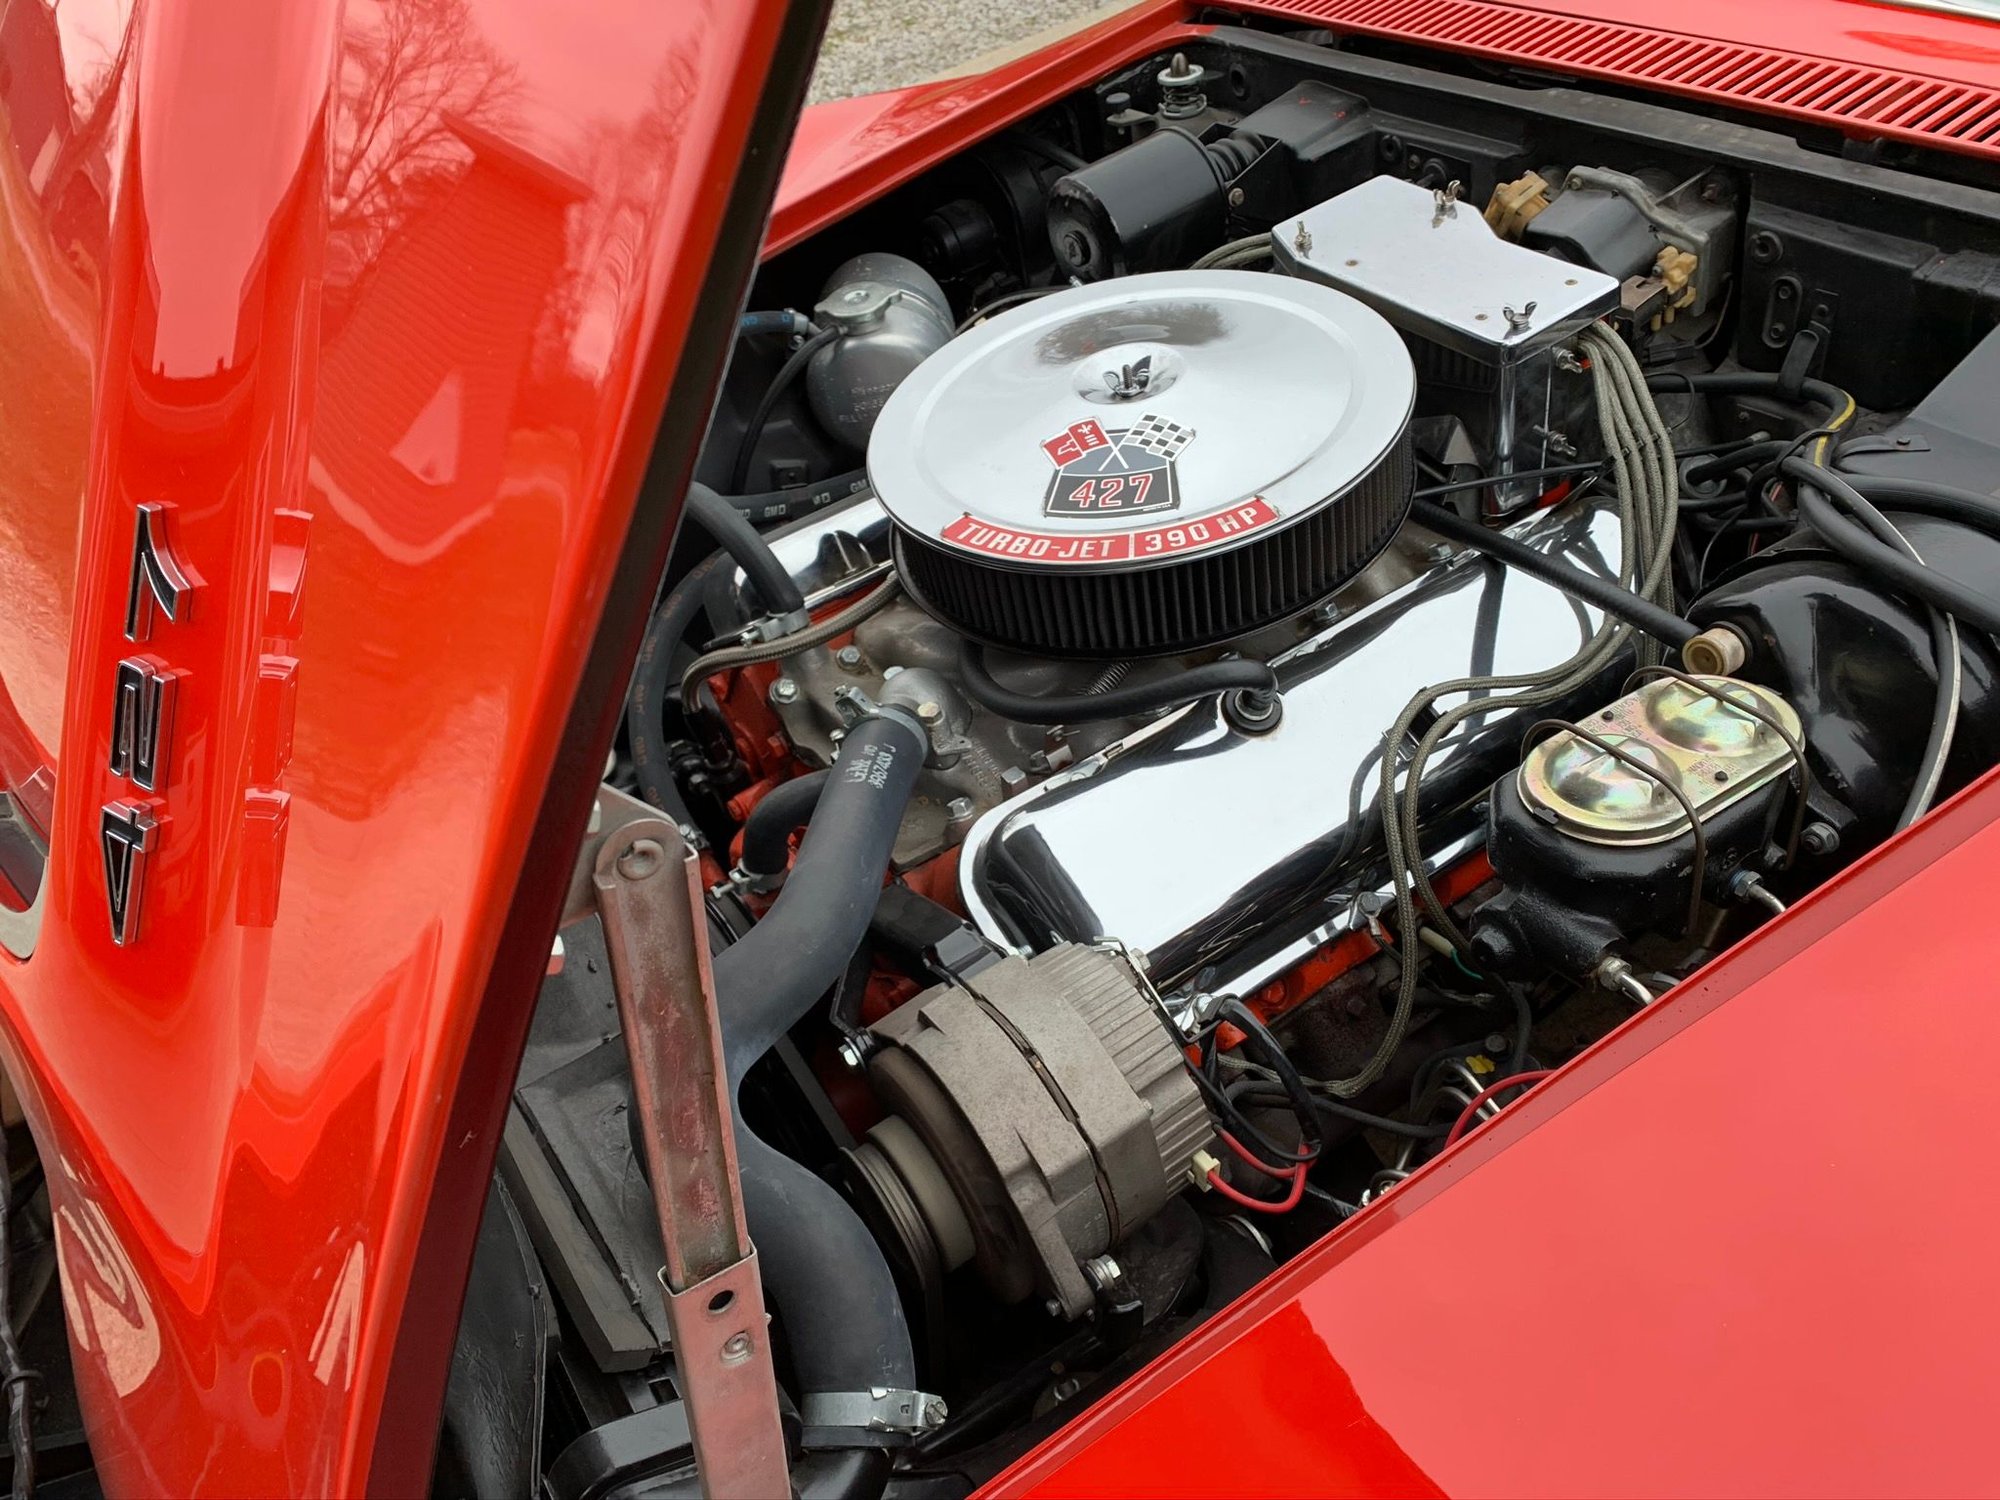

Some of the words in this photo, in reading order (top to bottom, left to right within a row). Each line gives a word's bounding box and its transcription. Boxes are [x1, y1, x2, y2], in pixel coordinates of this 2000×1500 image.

[1069, 473, 1153, 508] 427
[957, 521, 1115, 558] TURBO-JET
[1145, 525, 1210, 552] 390
[1216, 506, 1258, 533] HP
[102, 502, 193, 946] 427
